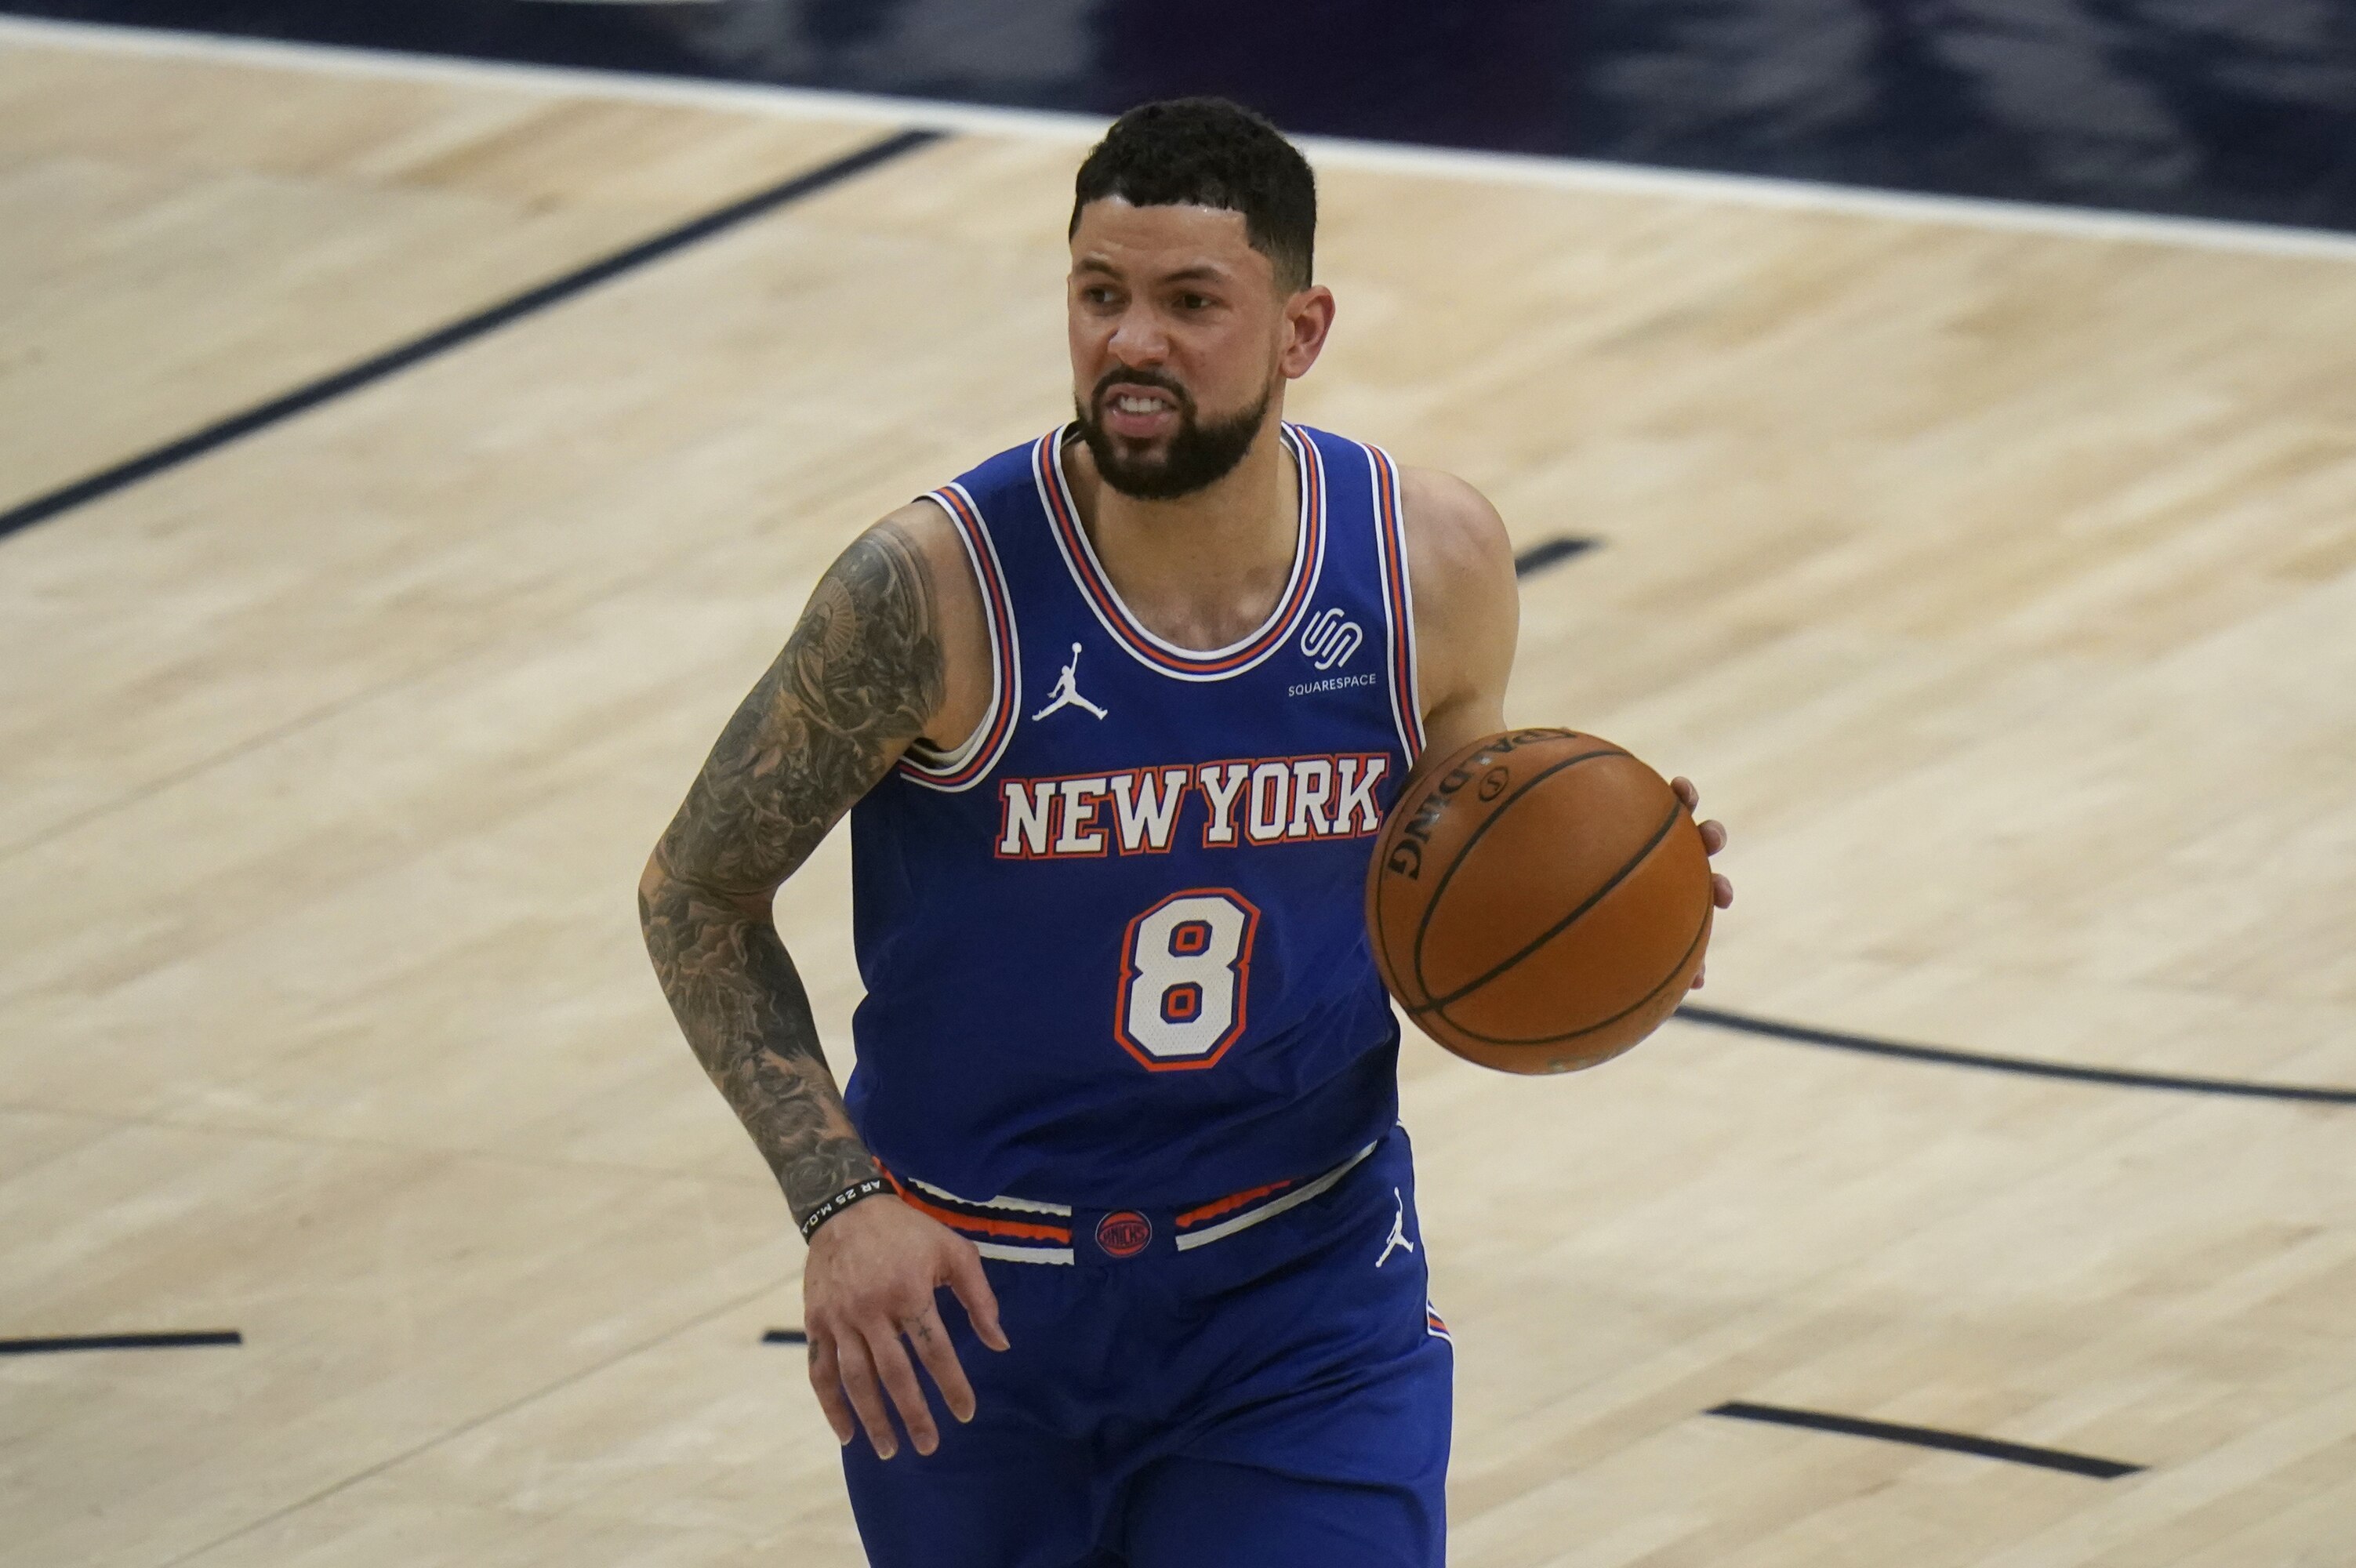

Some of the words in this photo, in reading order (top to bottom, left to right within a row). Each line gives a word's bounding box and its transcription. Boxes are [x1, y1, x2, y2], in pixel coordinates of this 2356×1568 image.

[1288, 673, 1376, 697] SQUARESPACE
[995, 764, 1193, 858] NEW
[1195, 753, 1391, 848] YORK
[1387, 729, 1576, 881] PALDING
[1113, 887, 1261, 1073] 8
[835, 1189, 856, 1205] 25
[860, 1180, 880, 1192] AR
